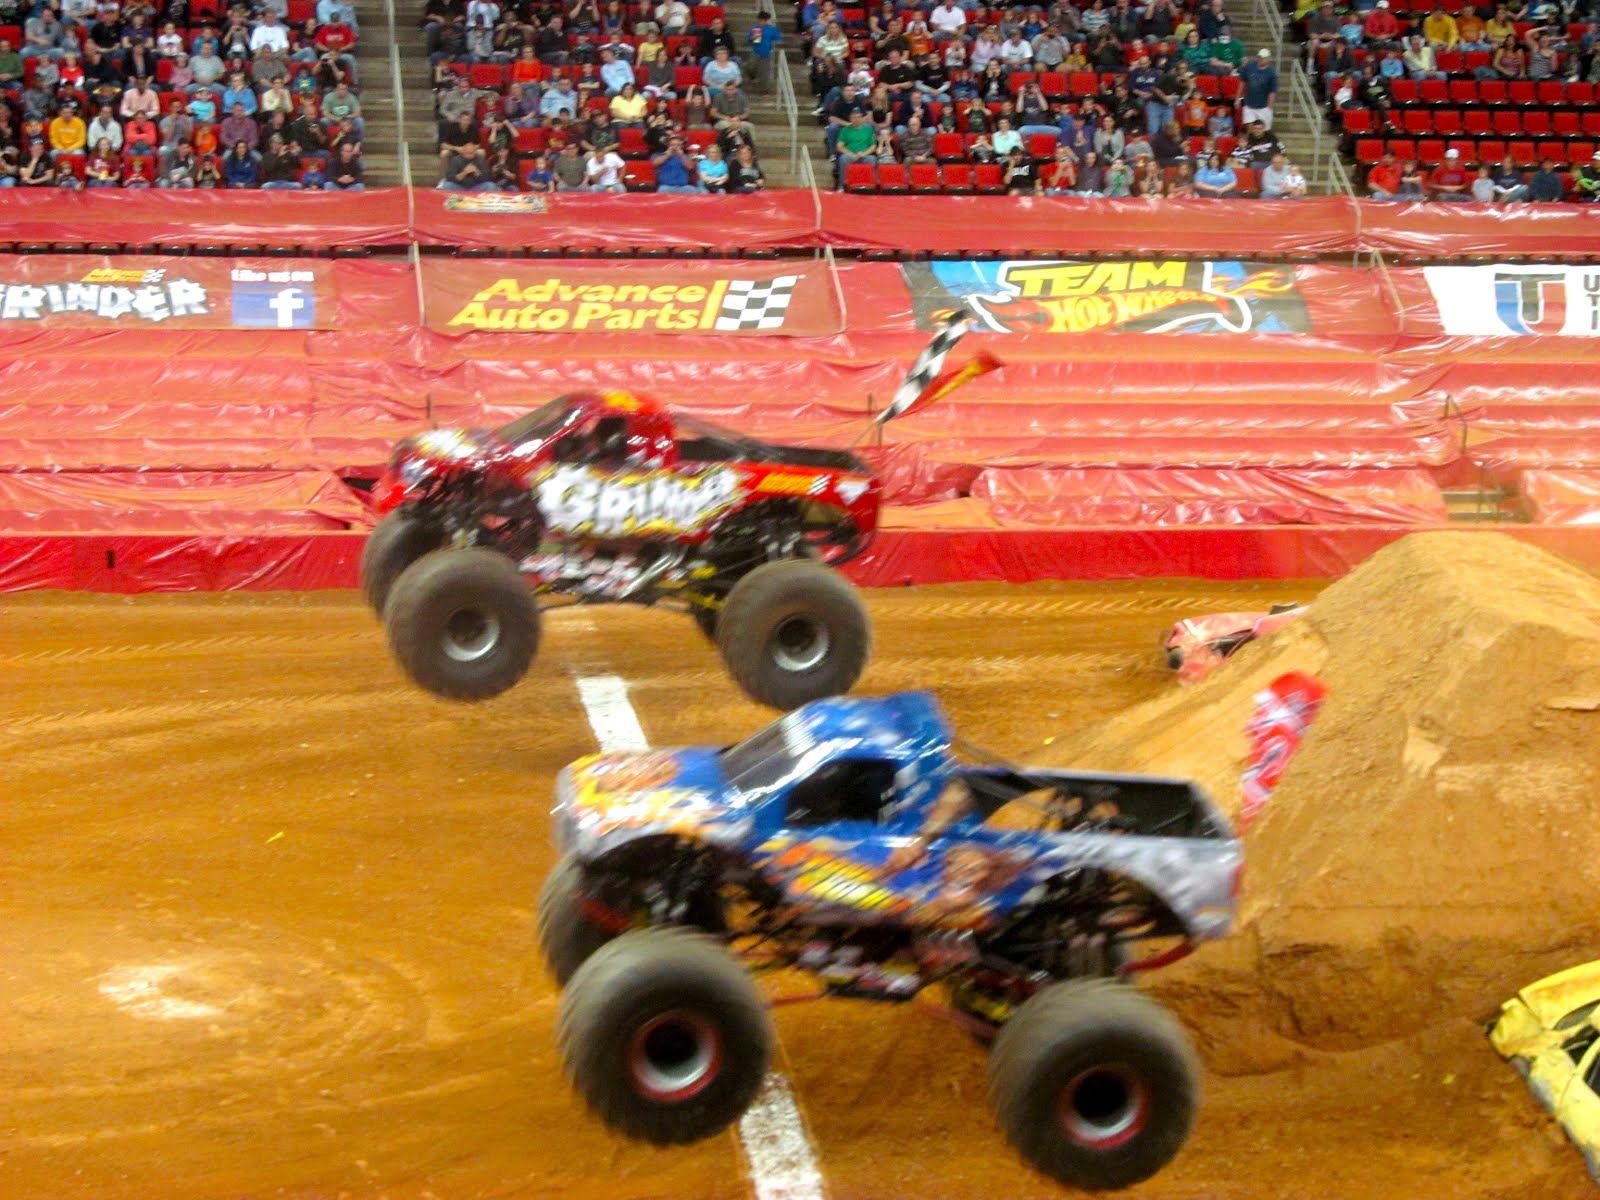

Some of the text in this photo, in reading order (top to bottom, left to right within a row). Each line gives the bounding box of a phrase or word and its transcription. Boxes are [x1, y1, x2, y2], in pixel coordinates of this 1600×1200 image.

[472, 278, 709, 302] Advance
[1008, 261, 1189, 296] TEAM
[448, 302, 700, 330] Auto Parts
